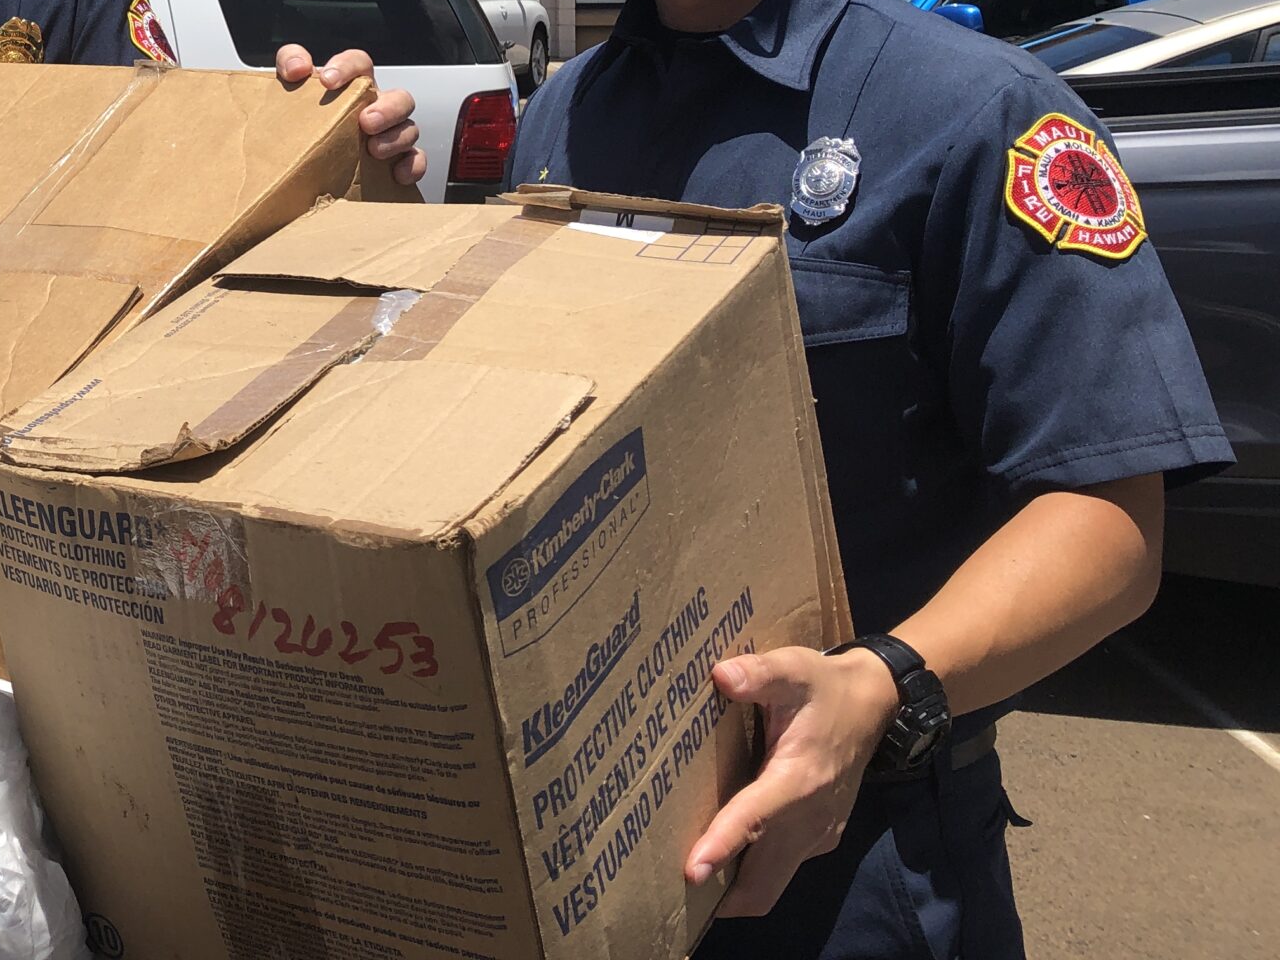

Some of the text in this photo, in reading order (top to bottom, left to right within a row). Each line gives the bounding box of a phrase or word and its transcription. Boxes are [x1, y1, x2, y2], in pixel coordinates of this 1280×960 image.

[1033, 125, 1086, 147] MAUI
[1017, 165, 1053, 223] FIRE
[1039, 155, 1054, 178] MAUI
[802, 208, 827, 218] MAUI
[531, 451, 636, 575] Kimberly-Clark
[58, 535, 127, 570] CLOTHING
[63, 563, 82, 584] DE
[1, 563, 164, 625] VESTUARIO DE PROTECCIÓN
[142, 638, 385, 699] READ GARMENT LABEL FOR IMPORTANT PRODUCT INFORMATION
[177, 636, 210, 653] Improper
[210, 644, 226, 657] Use
[225, 648, 242, 661] May
[242, 652, 265, 666] Result
[274, 659, 304, 674] Serious
[328, 671, 338, 679] or
[338, 670, 364, 684] Death
[523, 592, 640, 755] KleenGuard
[153, 693, 177, 706] OTHER
[177, 699, 222, 718] PROTECTIVE
[211, 683, 234, 696] Flame
[234, 688, 270, 704] Resistant
[270, 694, 306, 711] Coveralls
[532, 587, 710, 830] PROTECTIVE CLOTHING
[541, 587, 755, 882] VÊTEMENTS DE PROTECTION
[170, 753, 202, 769] VEUILLEZ
[202, 761, 221, 774] LIRE
[266, 777, 285, 790] AFIN
[330, 791, 348, 804] DES
[348, 792, 428, 823] RENSEIGNEMENTS
[226, 751, 242, 763] Une
[328, 774, 347, 787] peut
[347, 778, 374, 792] causer
[374, 783, 386, 793] de
[425, 789, 466, 810] blessures
[467, 797, 481, 809] ou
[553, 793, 652, 937] VESTUARIO
[650, 764, 673, 820] DE
